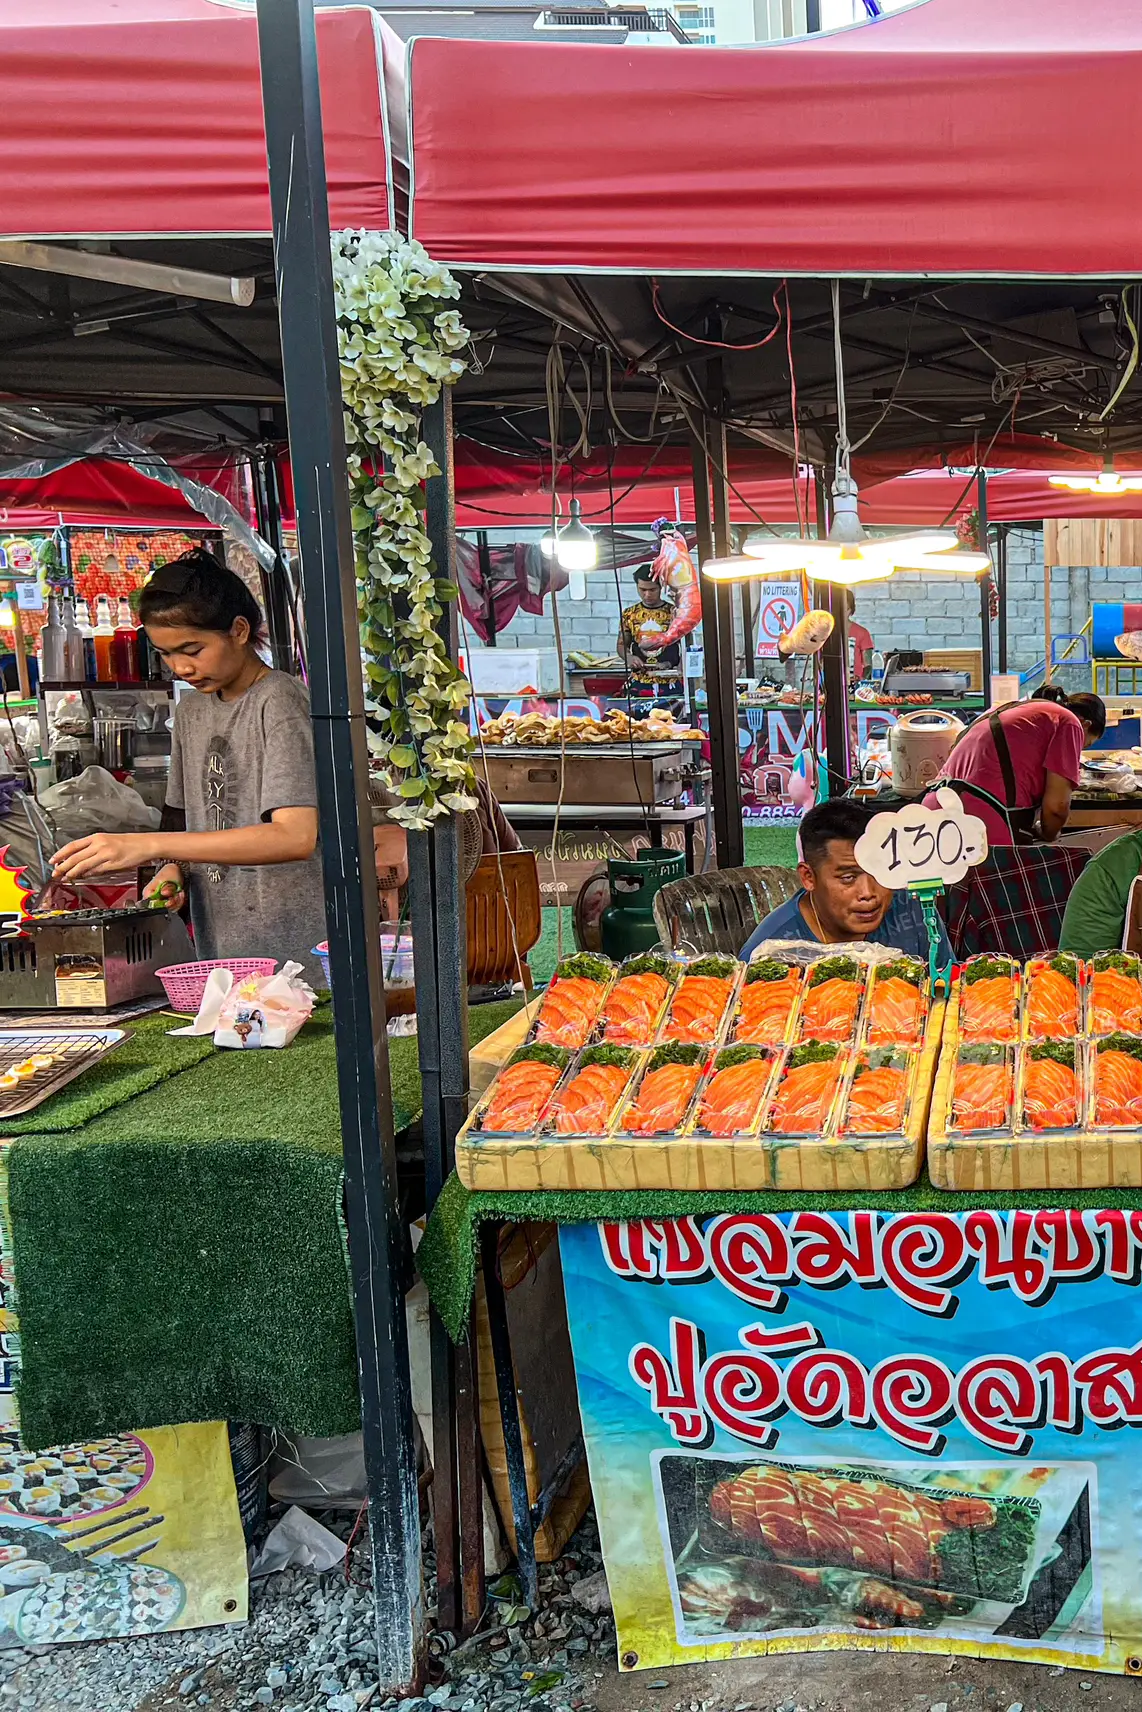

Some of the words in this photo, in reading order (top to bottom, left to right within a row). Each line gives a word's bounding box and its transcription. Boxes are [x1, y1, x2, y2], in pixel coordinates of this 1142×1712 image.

[763, 585, 771, 596] NO
[772, 584, 797, 596] LITTERING
[881, 820, 975, 871] 130.-
